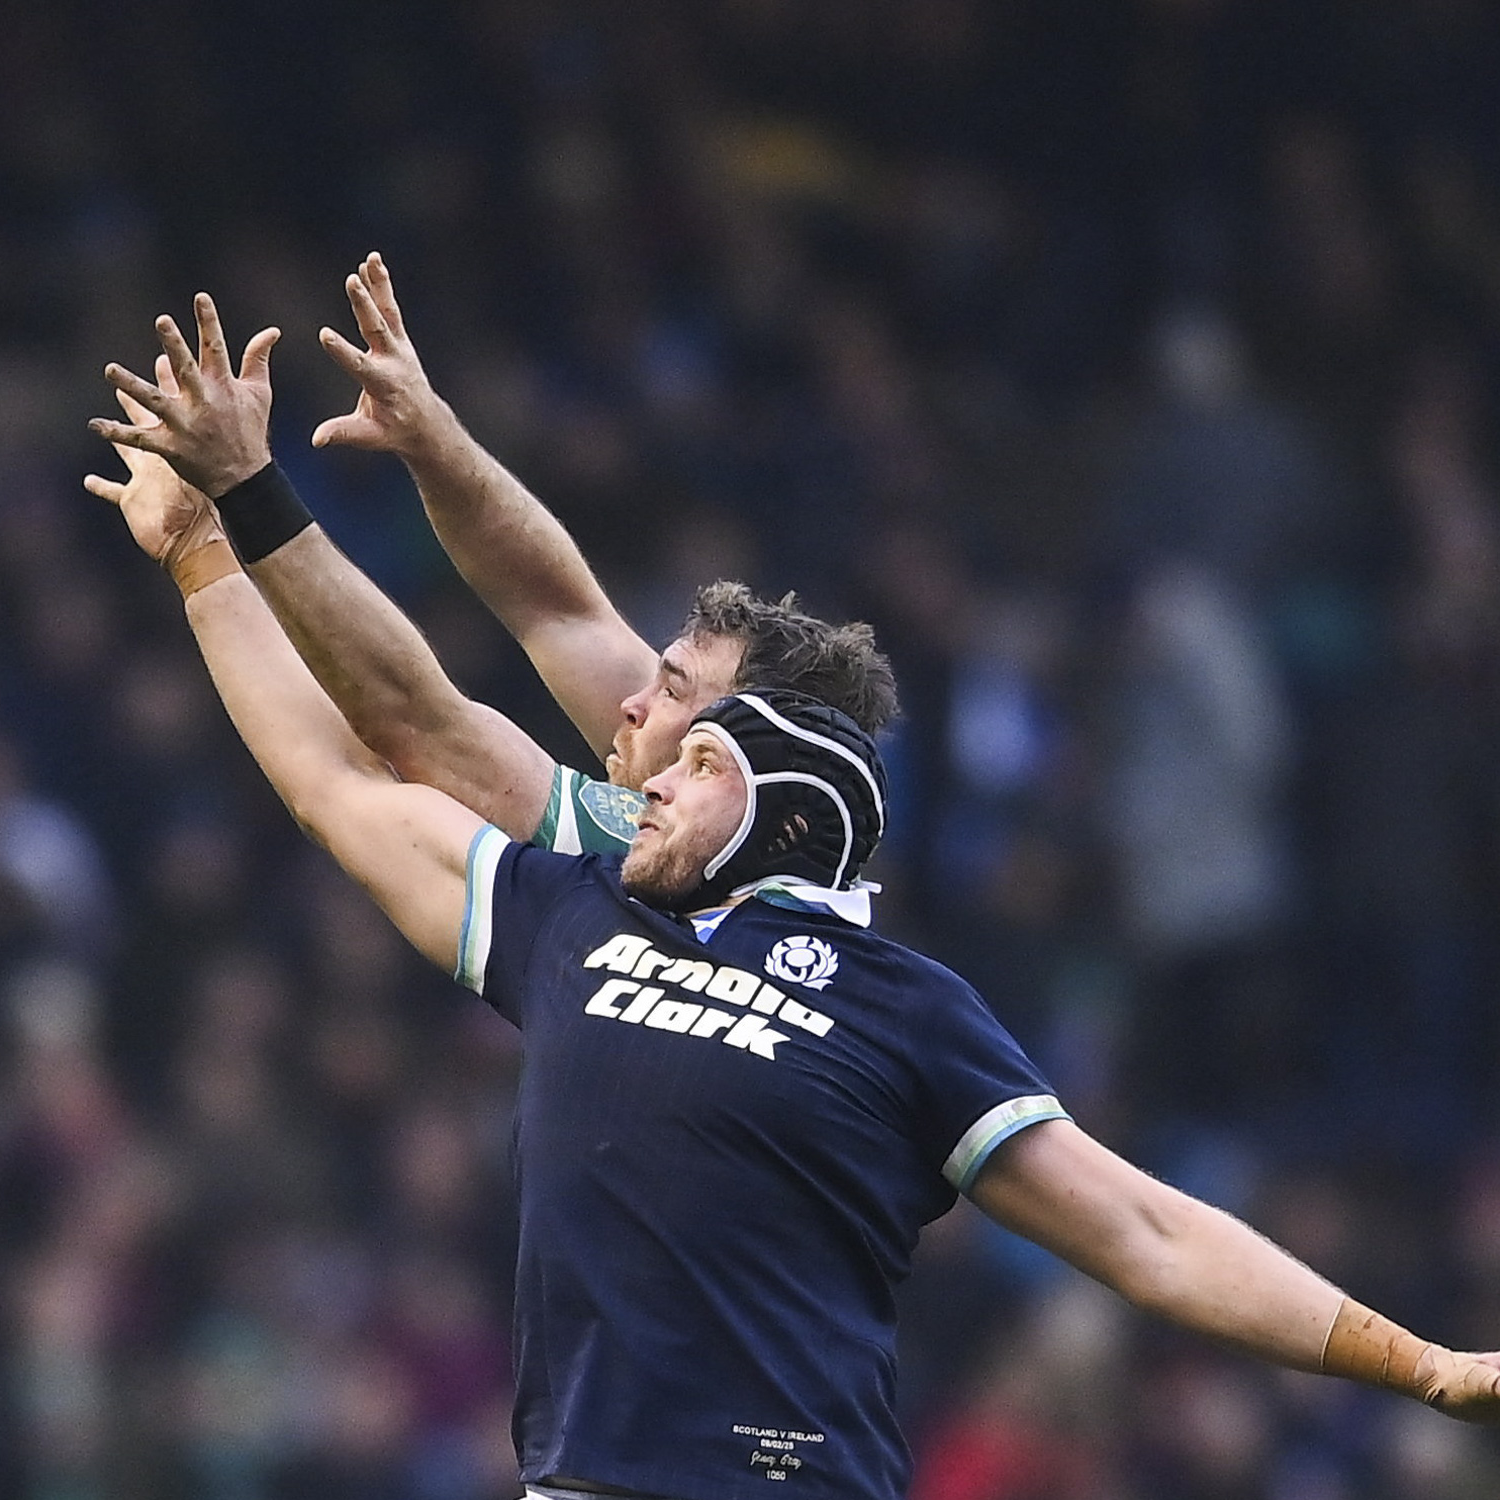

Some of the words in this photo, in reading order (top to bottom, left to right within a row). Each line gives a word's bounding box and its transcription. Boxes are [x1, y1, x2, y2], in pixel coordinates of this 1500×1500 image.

[584, 978, 791, 1061] Clark
[733, 1425, 778, 1438] SCOTLAND
[787, 1431, 825, 1443] IRELAND
